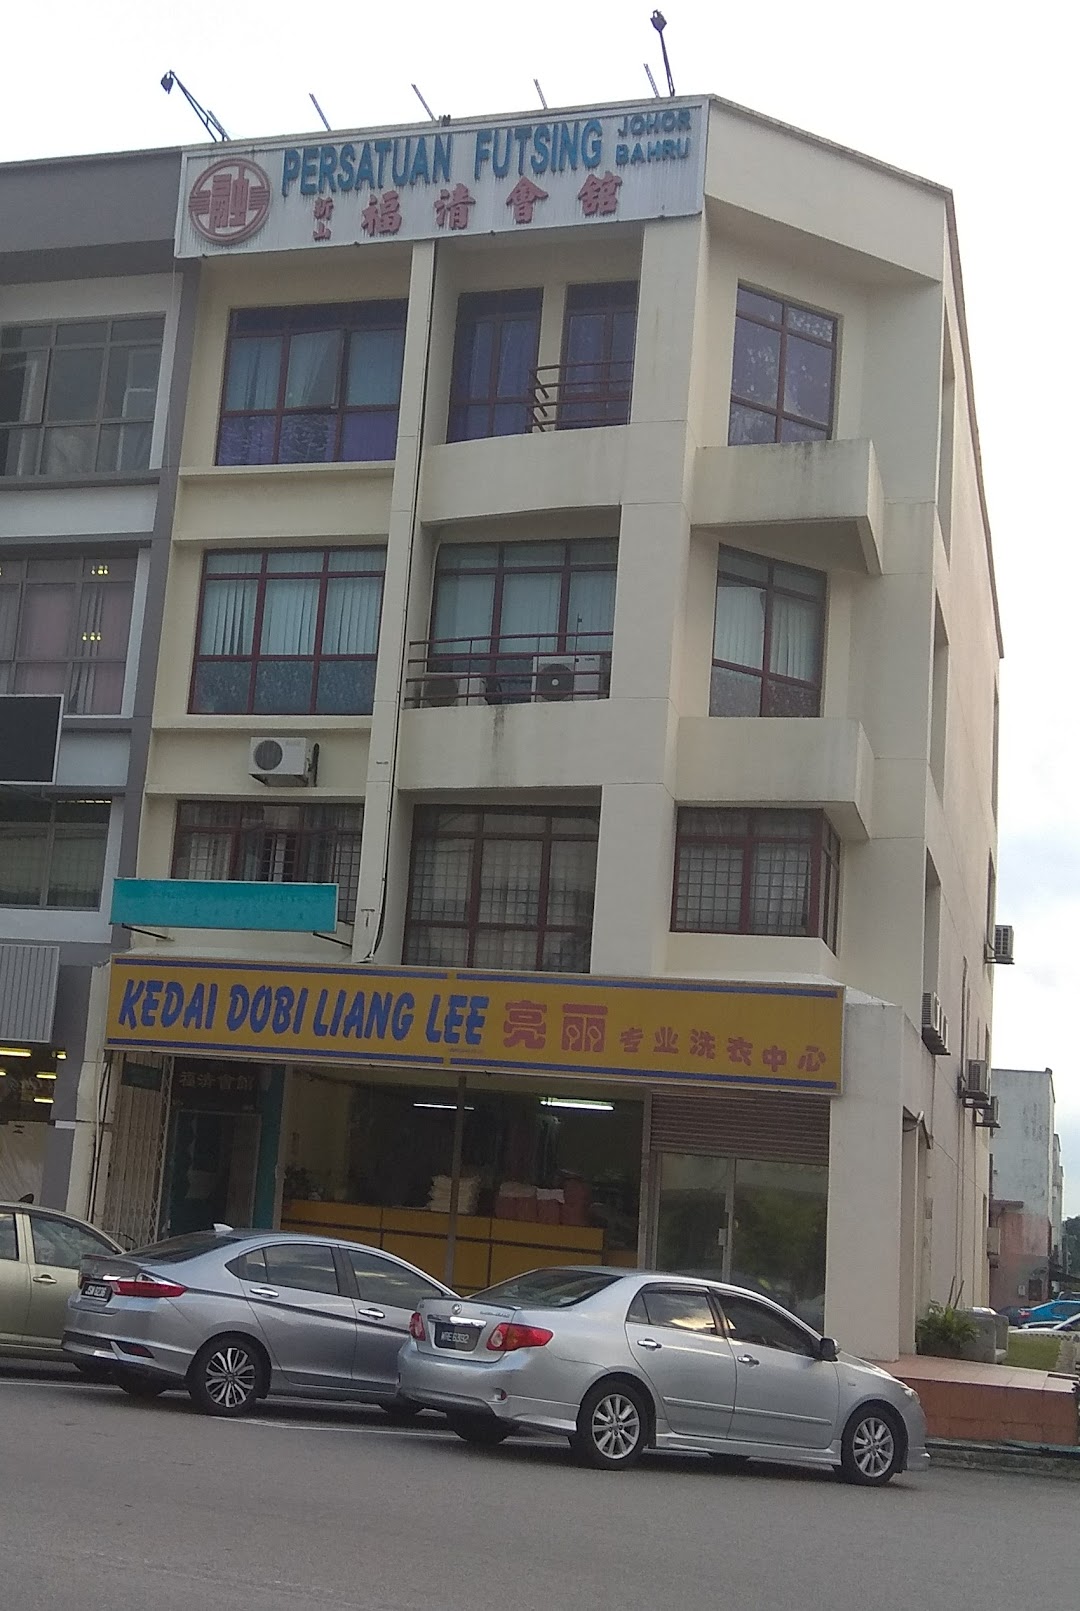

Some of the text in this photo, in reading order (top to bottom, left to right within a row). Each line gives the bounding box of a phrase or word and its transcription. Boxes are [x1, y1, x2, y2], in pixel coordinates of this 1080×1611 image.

[615, 137, 690, 165] BAHRU
[617, 108, 692, 137] JOHOR
[281, 118, 602, 197] PERSATUAN FUTSING
[118, 979, 490, 1045] KEDAI DOBI LIANG LEE
[503, 1000, 827, 1073] 亮丽 专业洗衣中心
